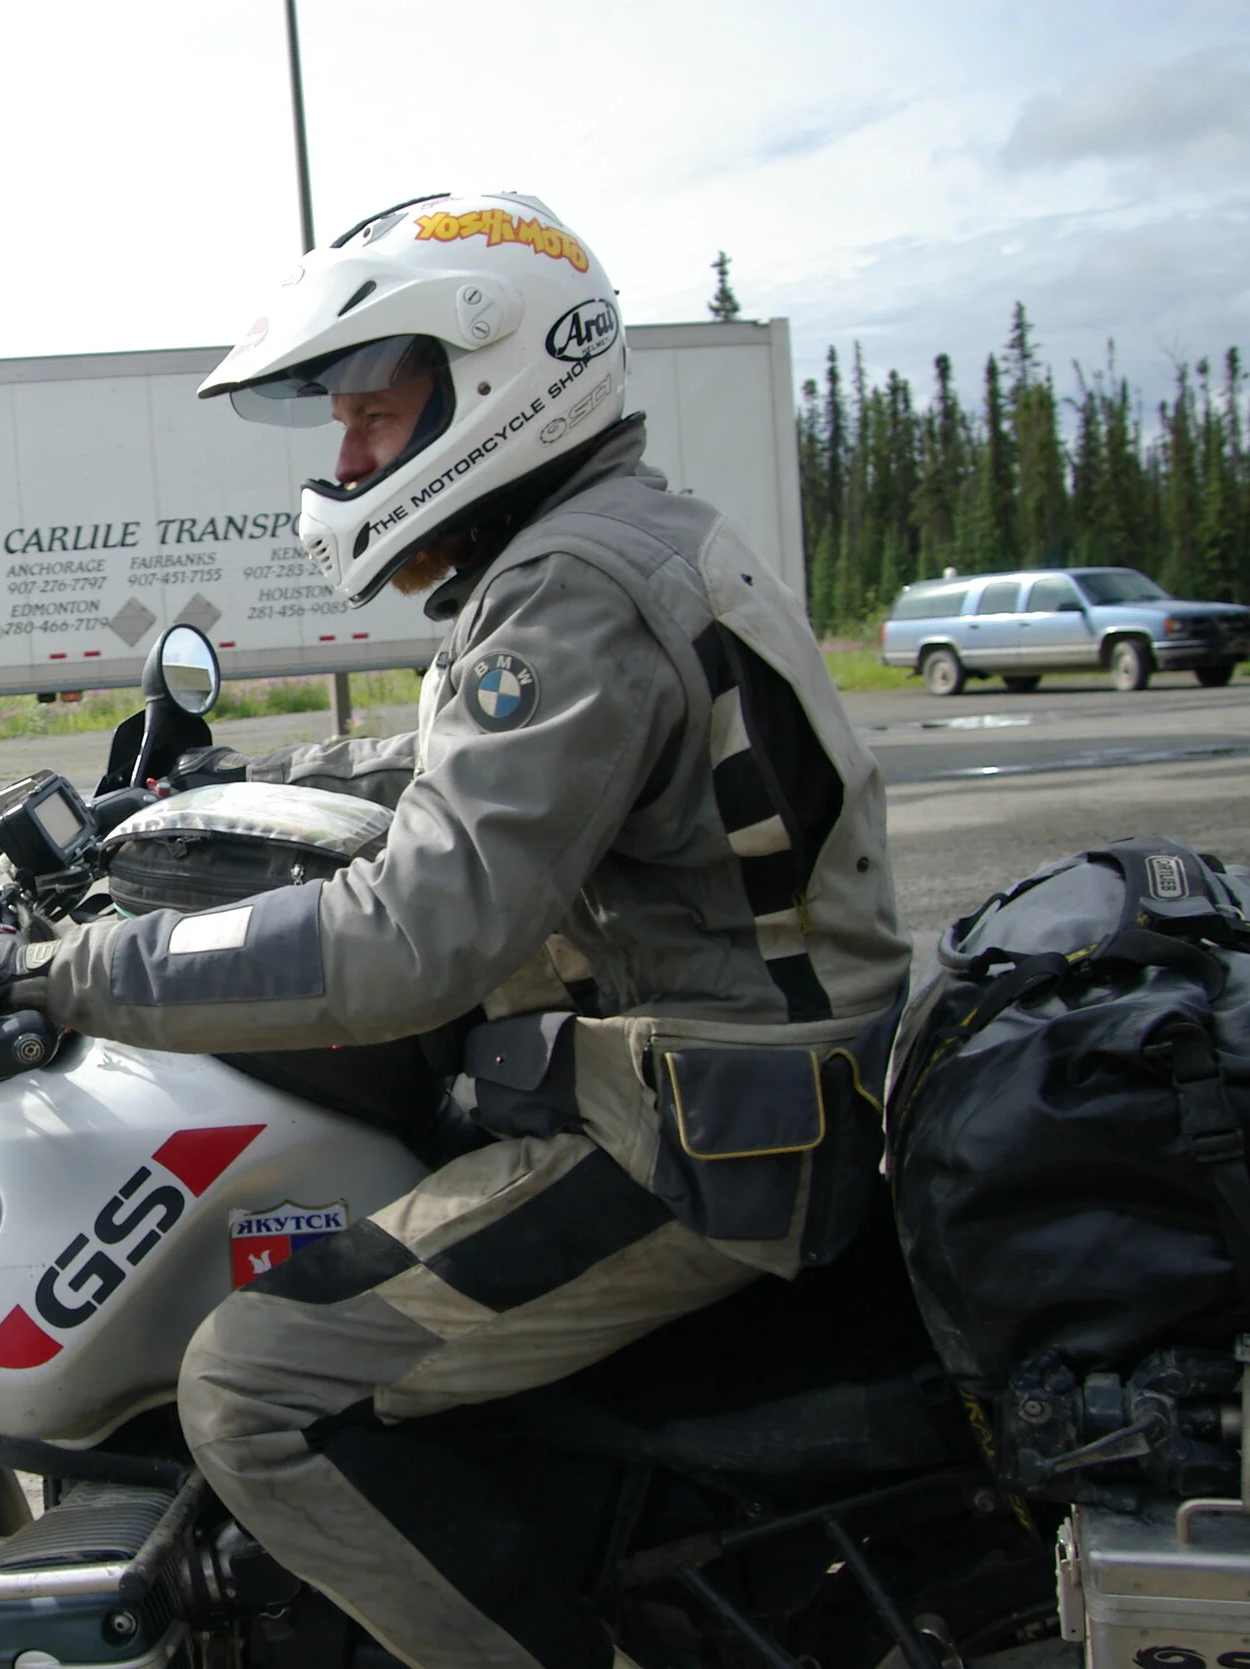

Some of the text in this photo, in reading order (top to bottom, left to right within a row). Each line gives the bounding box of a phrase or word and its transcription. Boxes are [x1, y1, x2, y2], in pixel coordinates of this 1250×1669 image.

[556, 301, 614, 357] Arai
[368, 505, 408, 535] THE
[410, 398, 545, 508] MOTORCYCLE
[4, 521, 141, 554] CARLILE
[6, 559, 106, 578] ANCHORAGE
[130, 552, 217, 570] FAIRBANKS
[7, 576, 108, 596] 907-276-7797
[127, 568, 223, 587] 907-451-7155
[259, 585, 334, 601] HOUSTON
[10, 599, 101, 618] EDMONTON
[246, 601, 348, 620] 281-456-9085
[5, 616, 111, 636] 780-466-7179
[474, 655, 533, 686] BMW
[237, 1212, 342, 1235] ЯКУТСК
[35, 1165, 185, 1329] GS
